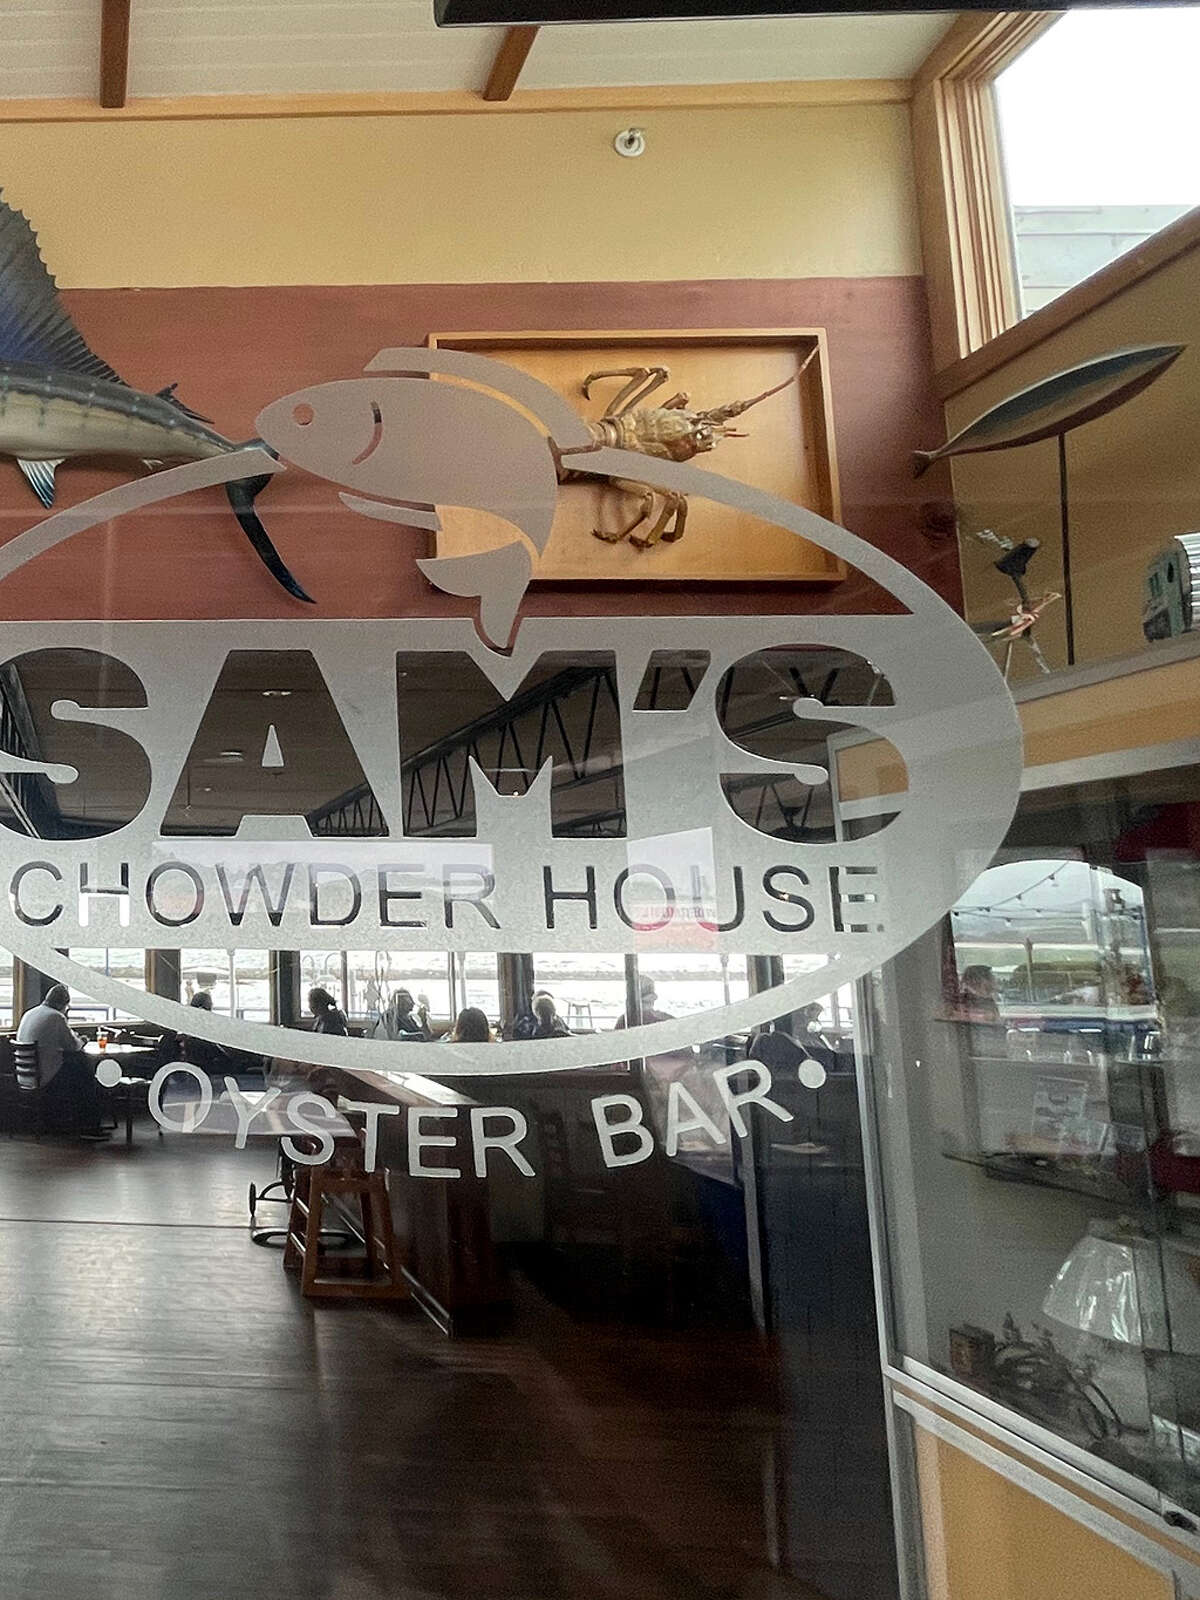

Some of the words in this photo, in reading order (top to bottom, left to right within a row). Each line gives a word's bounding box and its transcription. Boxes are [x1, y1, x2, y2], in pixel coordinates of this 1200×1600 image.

[9, 860, 502, 929] CHOWDER
[543, 864, 884, 933] HOUSE
[148, 1061, 535, 1178] OYSTER
[591, 1059, 794, 1168] BAR
